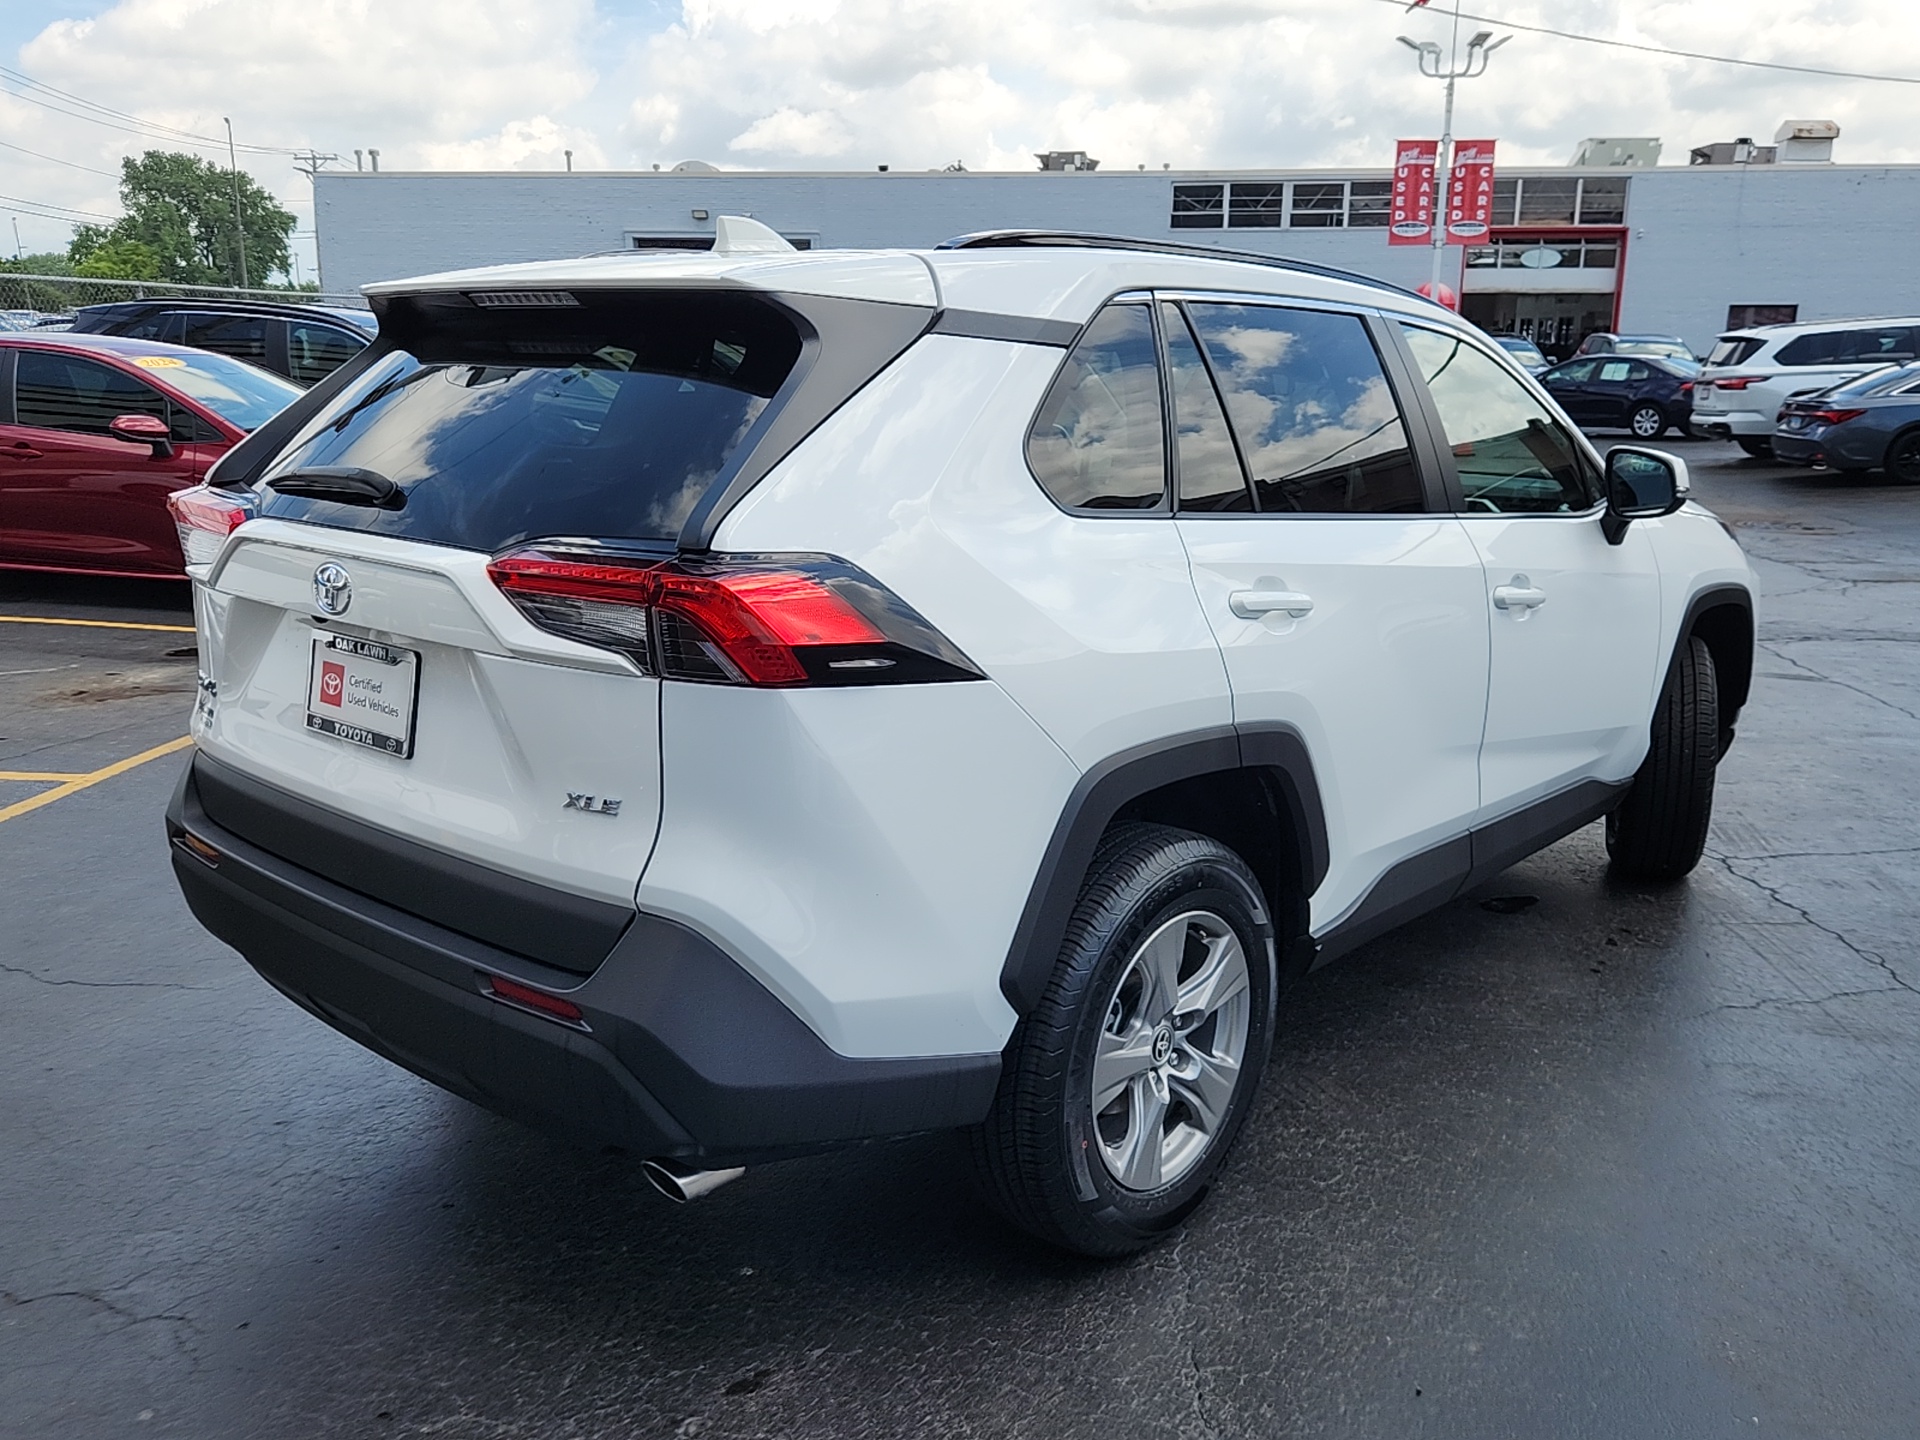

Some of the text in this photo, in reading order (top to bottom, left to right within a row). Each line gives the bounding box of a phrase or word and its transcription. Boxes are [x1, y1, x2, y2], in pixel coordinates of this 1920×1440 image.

[1394, 167, 1432, 221] USED CARS
[1451, 166, 1491, 221] USED CARS
[140, 359, 178, 367] 2024
[335, 637, 386, 660] OAK LAWN
[348, 674, 382, 694] Certified
[347, 692, 400, 718] Used Vehicles
[334, 722, 374, 745] TOYOTA
[561, 792, 623, 817] XLE
